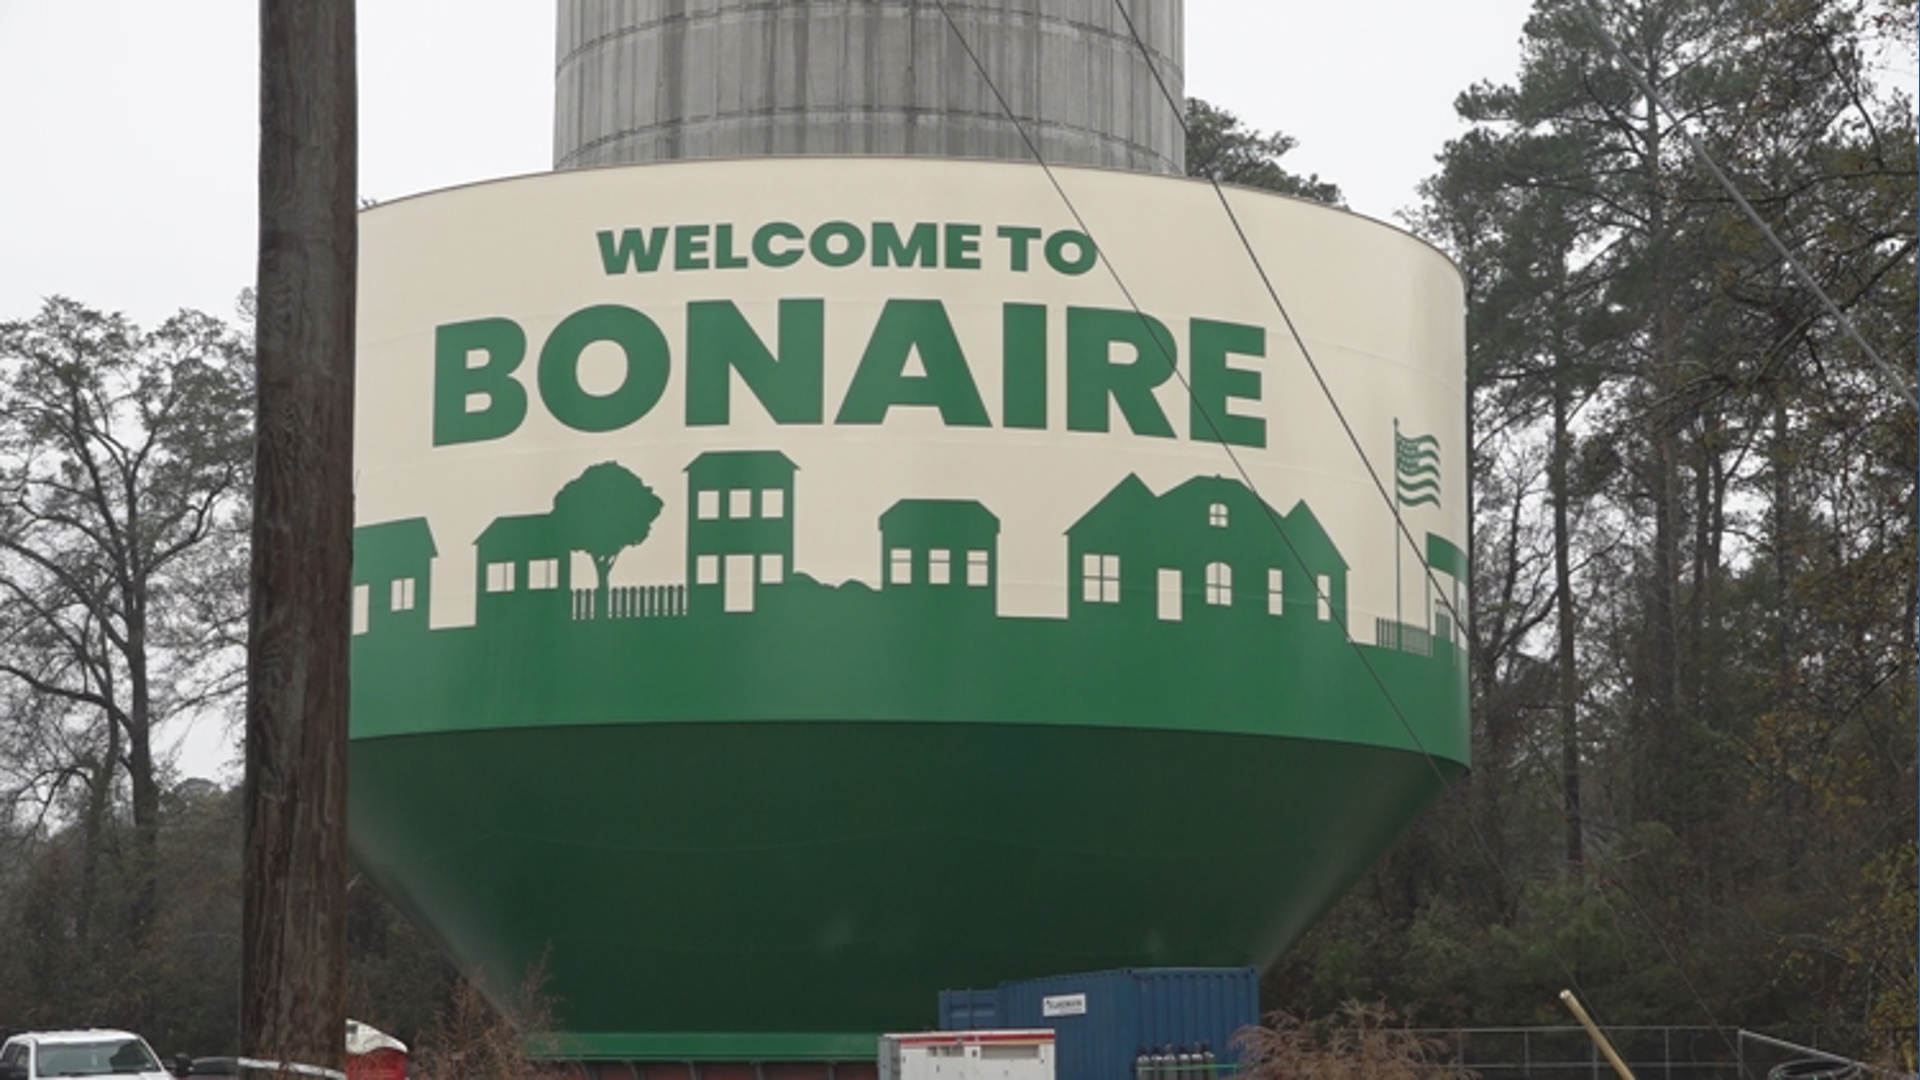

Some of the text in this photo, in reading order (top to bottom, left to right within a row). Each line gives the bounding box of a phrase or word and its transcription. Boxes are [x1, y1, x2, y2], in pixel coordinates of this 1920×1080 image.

[596, 221, 1098, 275] WELCOME TO
[433, 298, 1267, 448] BONAIRE
